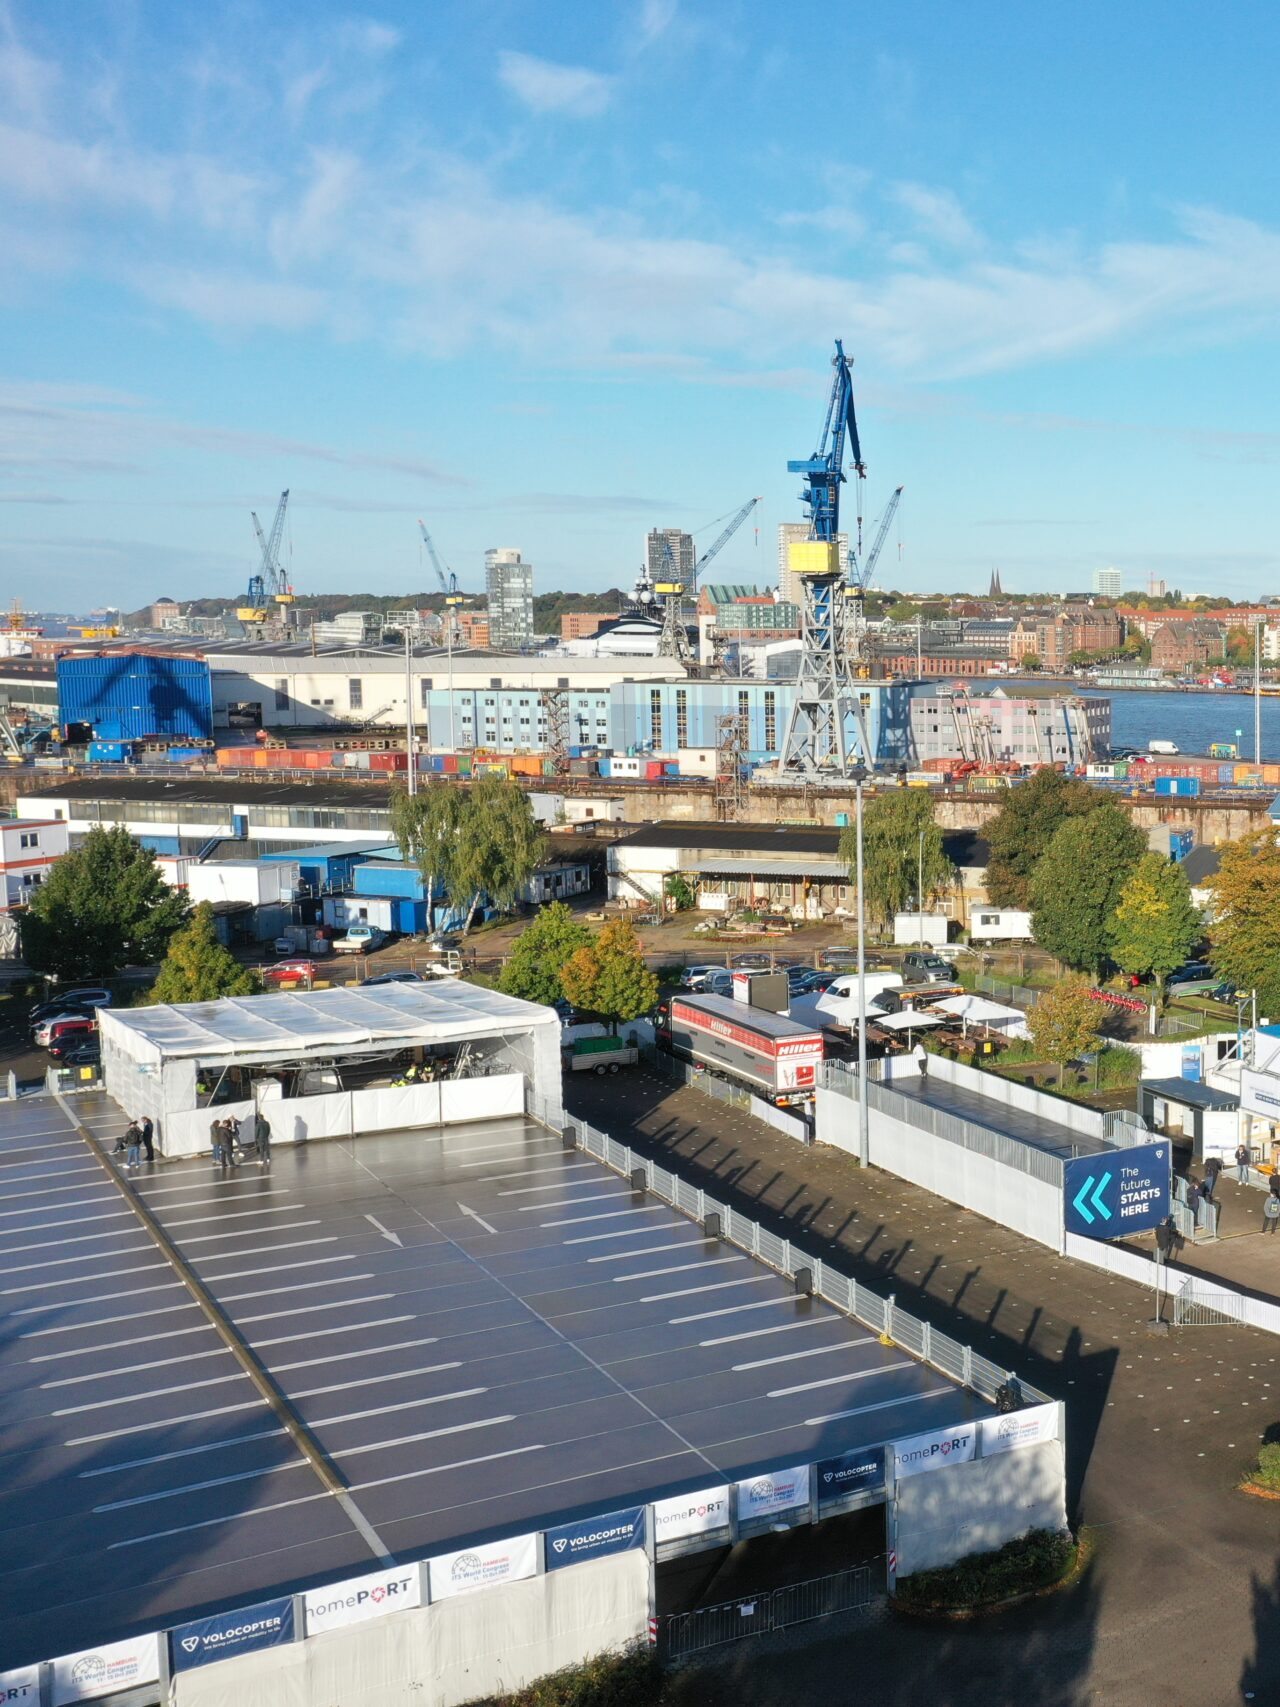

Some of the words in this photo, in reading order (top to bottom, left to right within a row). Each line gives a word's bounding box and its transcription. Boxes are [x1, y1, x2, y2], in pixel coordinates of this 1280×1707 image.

[710, 1020, 732, 1036] Hiller
[778, 1042, 821, 1055] Hiller
[1120, 1167, 1139, 1178] The
[1120, 1179, 1151, 1191] future
[1120, 1188, 1161, 1204] STARTS
[1120, 1203, 1150, 1218] HERE
[834, 1462, 877, 1479] VOLOCOPTER
[656, 1500, 724, 1525] homePORT
[569, 1524, 634, 1547] VOLOCOPTER
[463, 1569, 481, 1578] World
[202, 1617, 281, 1644] VOLOCOPTER
[72, 1676, 83, 1684] ITS
[84, 1670, 105, 1680] World
[106, 1663, 138, 1674] Congress
